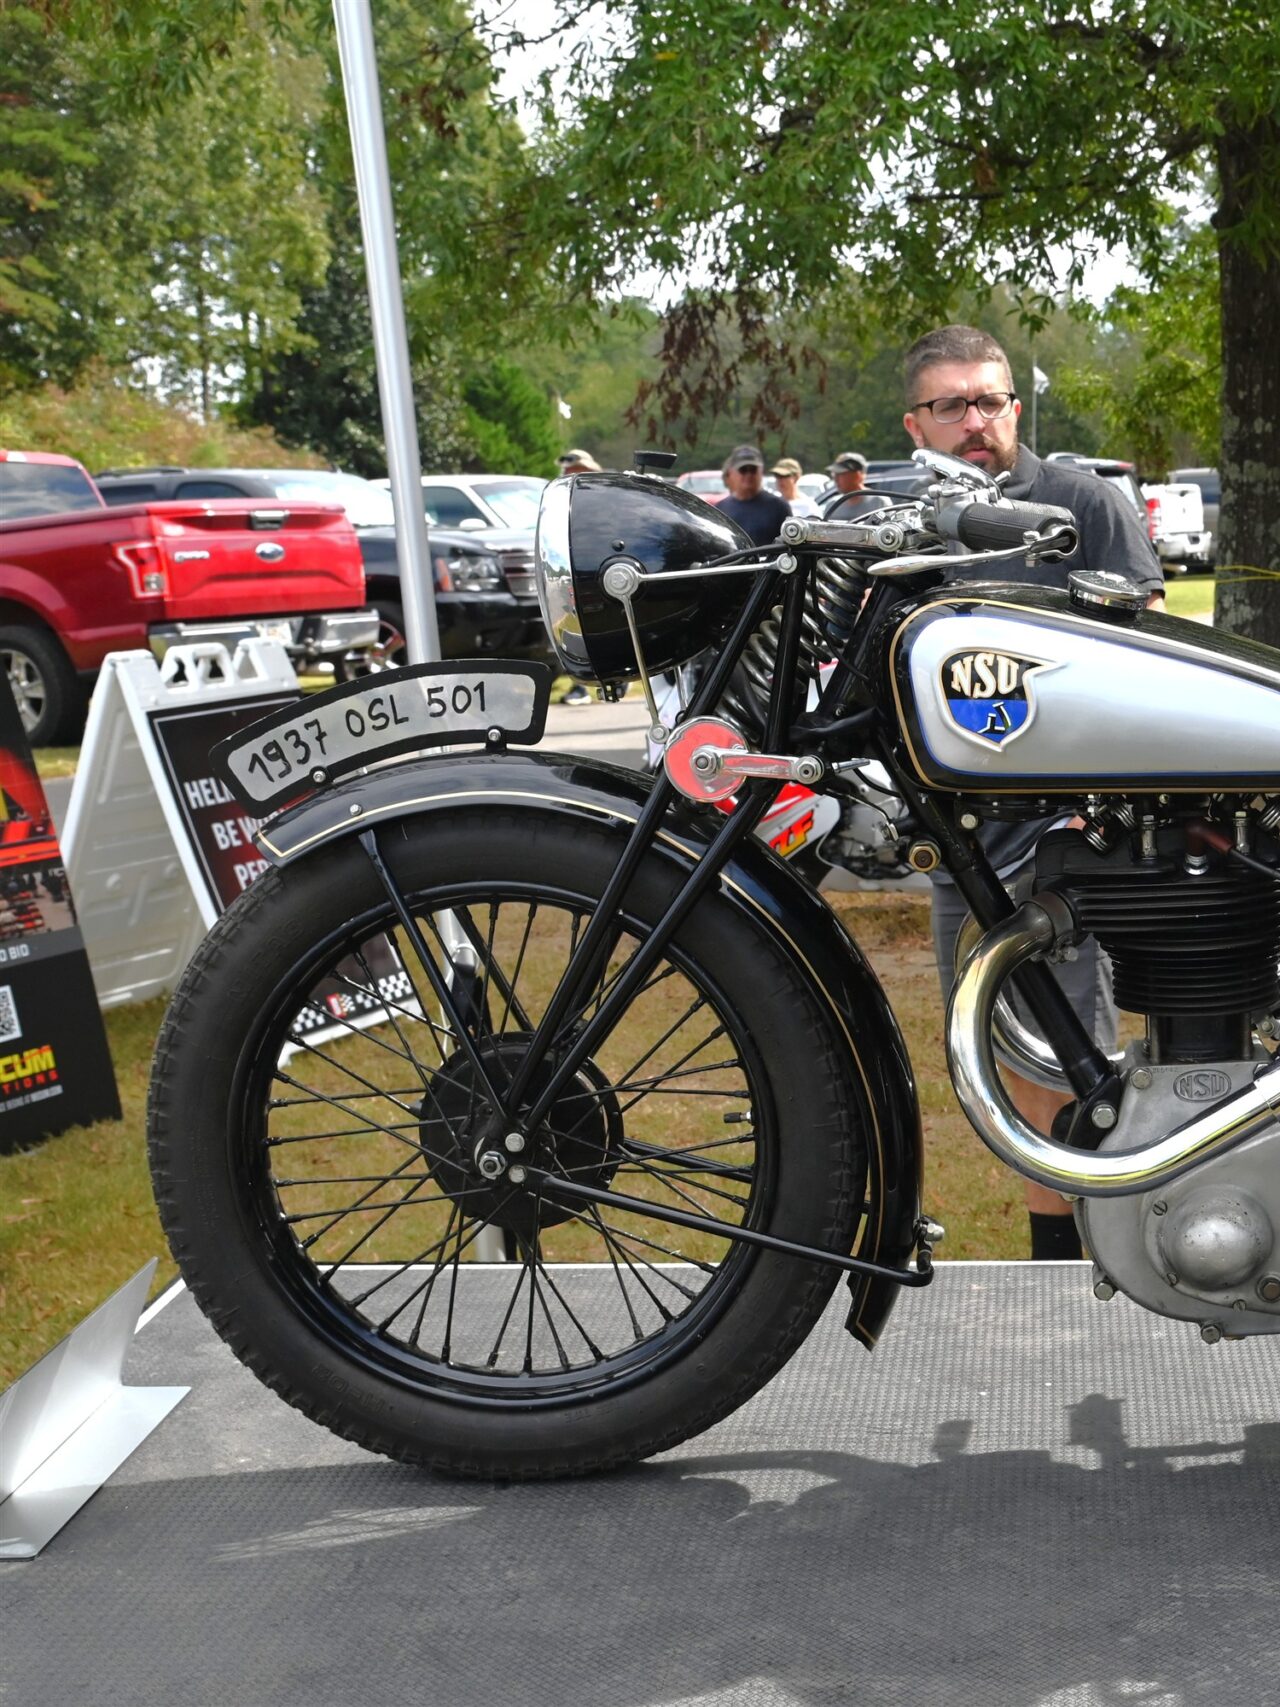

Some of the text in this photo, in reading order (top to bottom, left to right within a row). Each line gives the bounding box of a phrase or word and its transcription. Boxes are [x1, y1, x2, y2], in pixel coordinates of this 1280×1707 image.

[951, 653, 1019, 698] NSU
[248, 681, 486, 783] 1937 OSL 501
[211, 819, 243, 850] BE
[8, 944, 30, 959] BID
[1179, 1073, 1225, 1098] NSU
